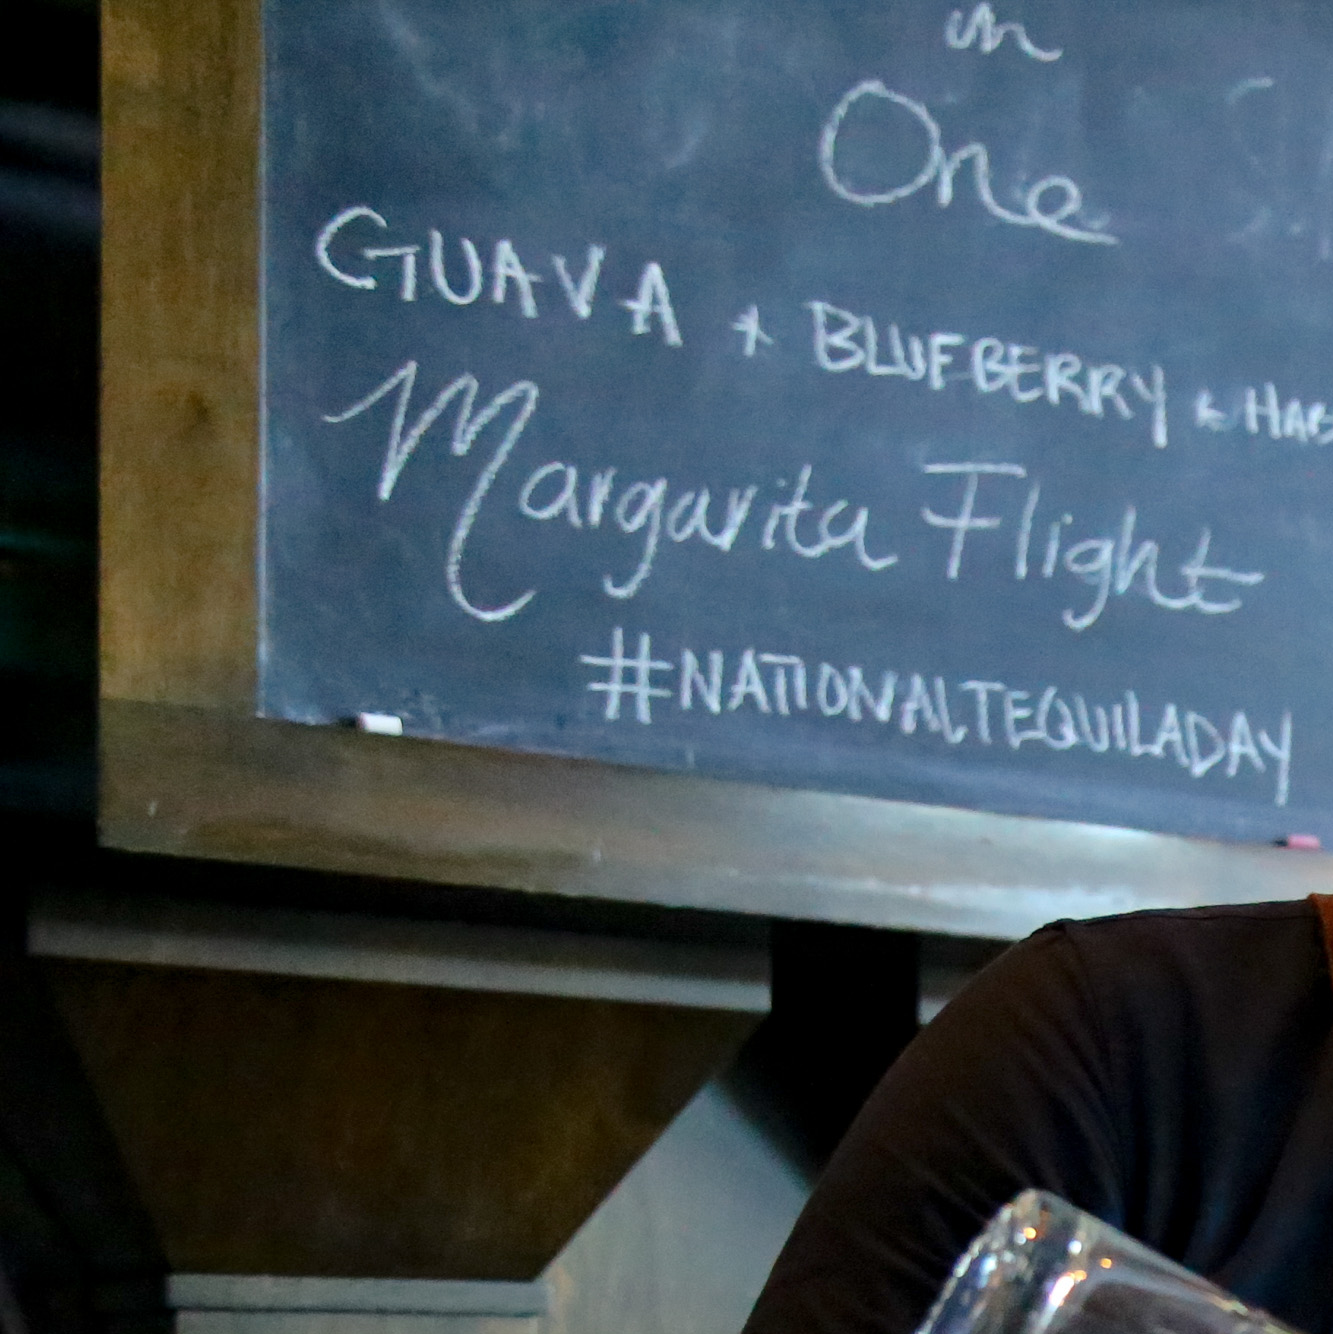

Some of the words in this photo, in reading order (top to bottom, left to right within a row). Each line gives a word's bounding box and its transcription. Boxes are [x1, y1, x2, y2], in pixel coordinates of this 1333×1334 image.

[819, 79, 1121, 245] One
[315, 205, 683, 348] GUAVA
[803, 300, 1168, 450] BLUEBERRY
[322, 360, 899, 622] Margarita
[920, 462, 1265, 632] Flight
[579, 626, 1293, 807] #NATIONALTEQUILADAY
